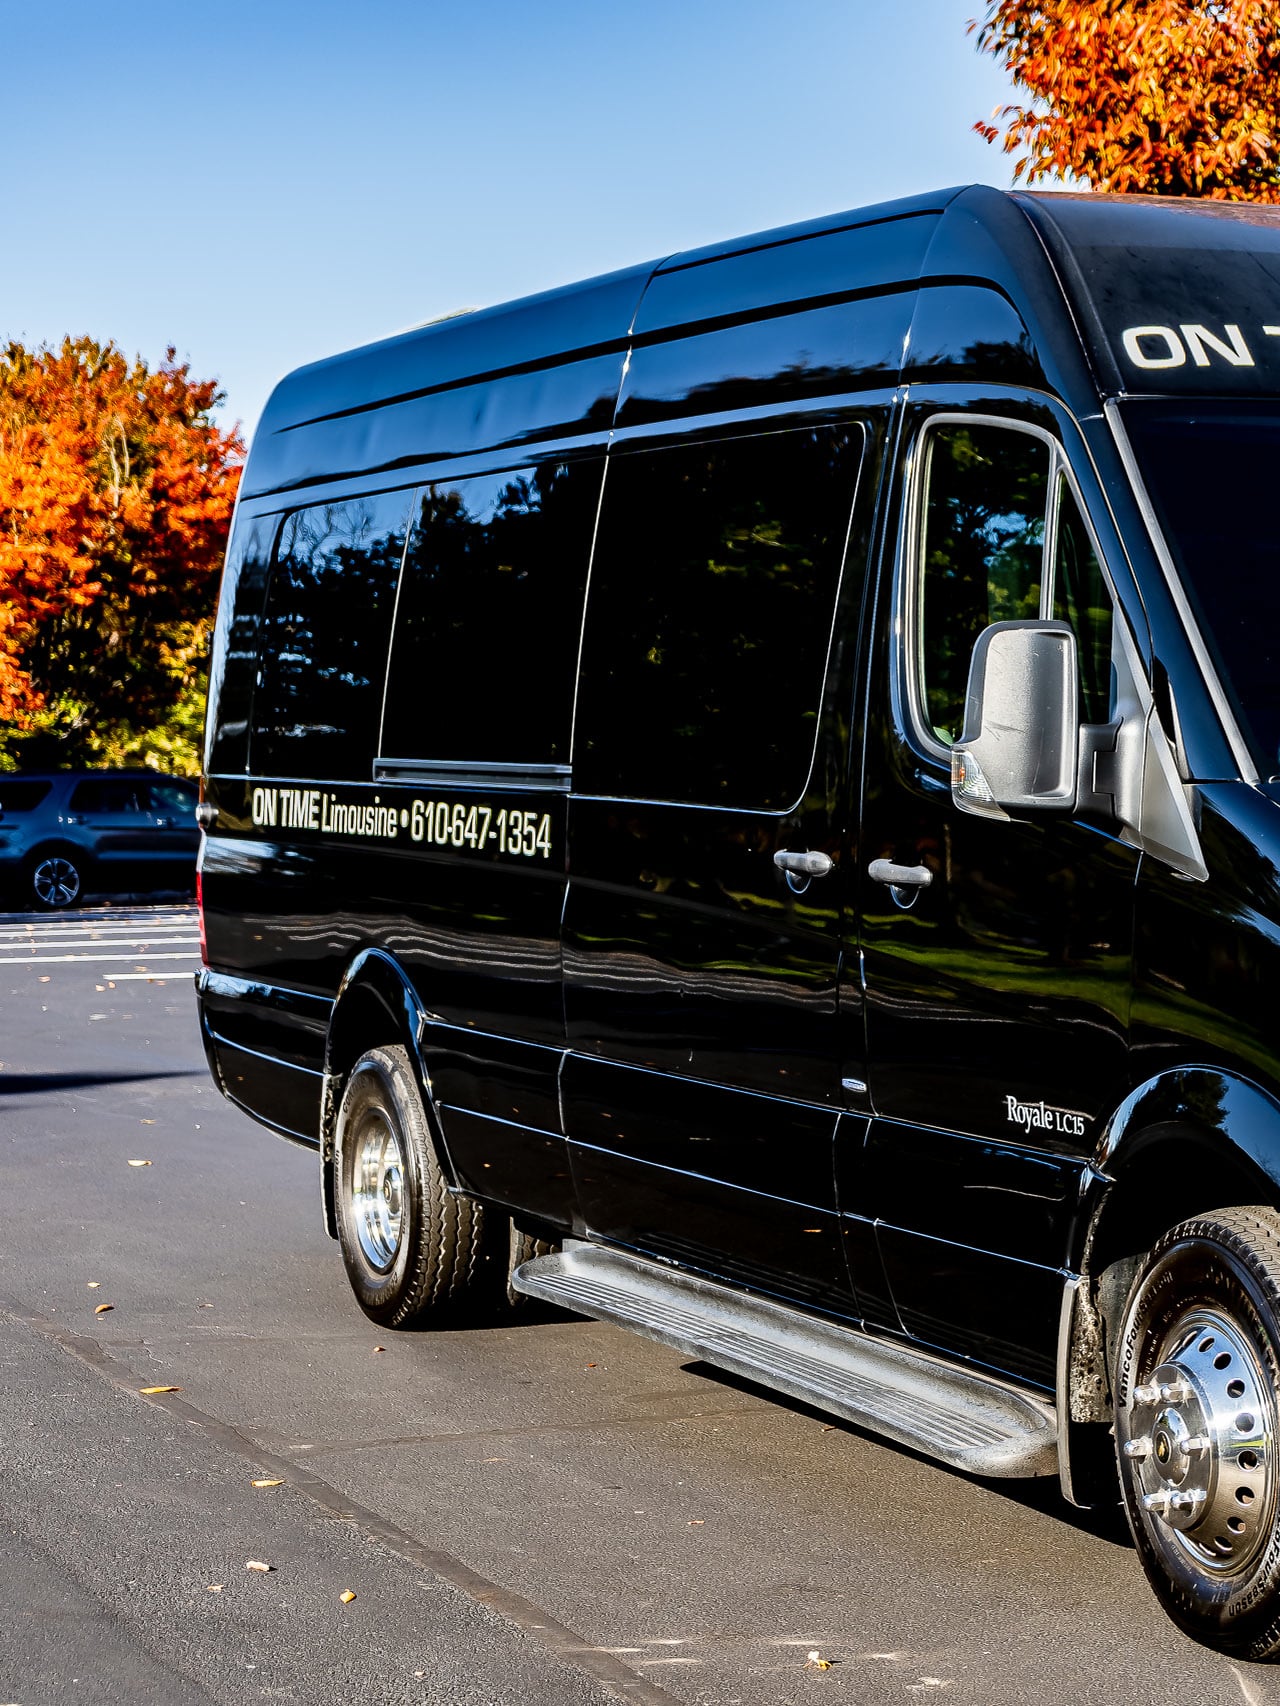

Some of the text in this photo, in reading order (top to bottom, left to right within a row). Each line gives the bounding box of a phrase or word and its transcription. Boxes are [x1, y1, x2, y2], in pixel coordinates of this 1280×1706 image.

[1122, 324, 1255, 370] ON
[252, 787, 277, 826] ON
[279, 790, 321, 830] TIME
[321, 793, 398, 839] Limousine
[1005, 1095, 1085, 1135] Royale LC15
